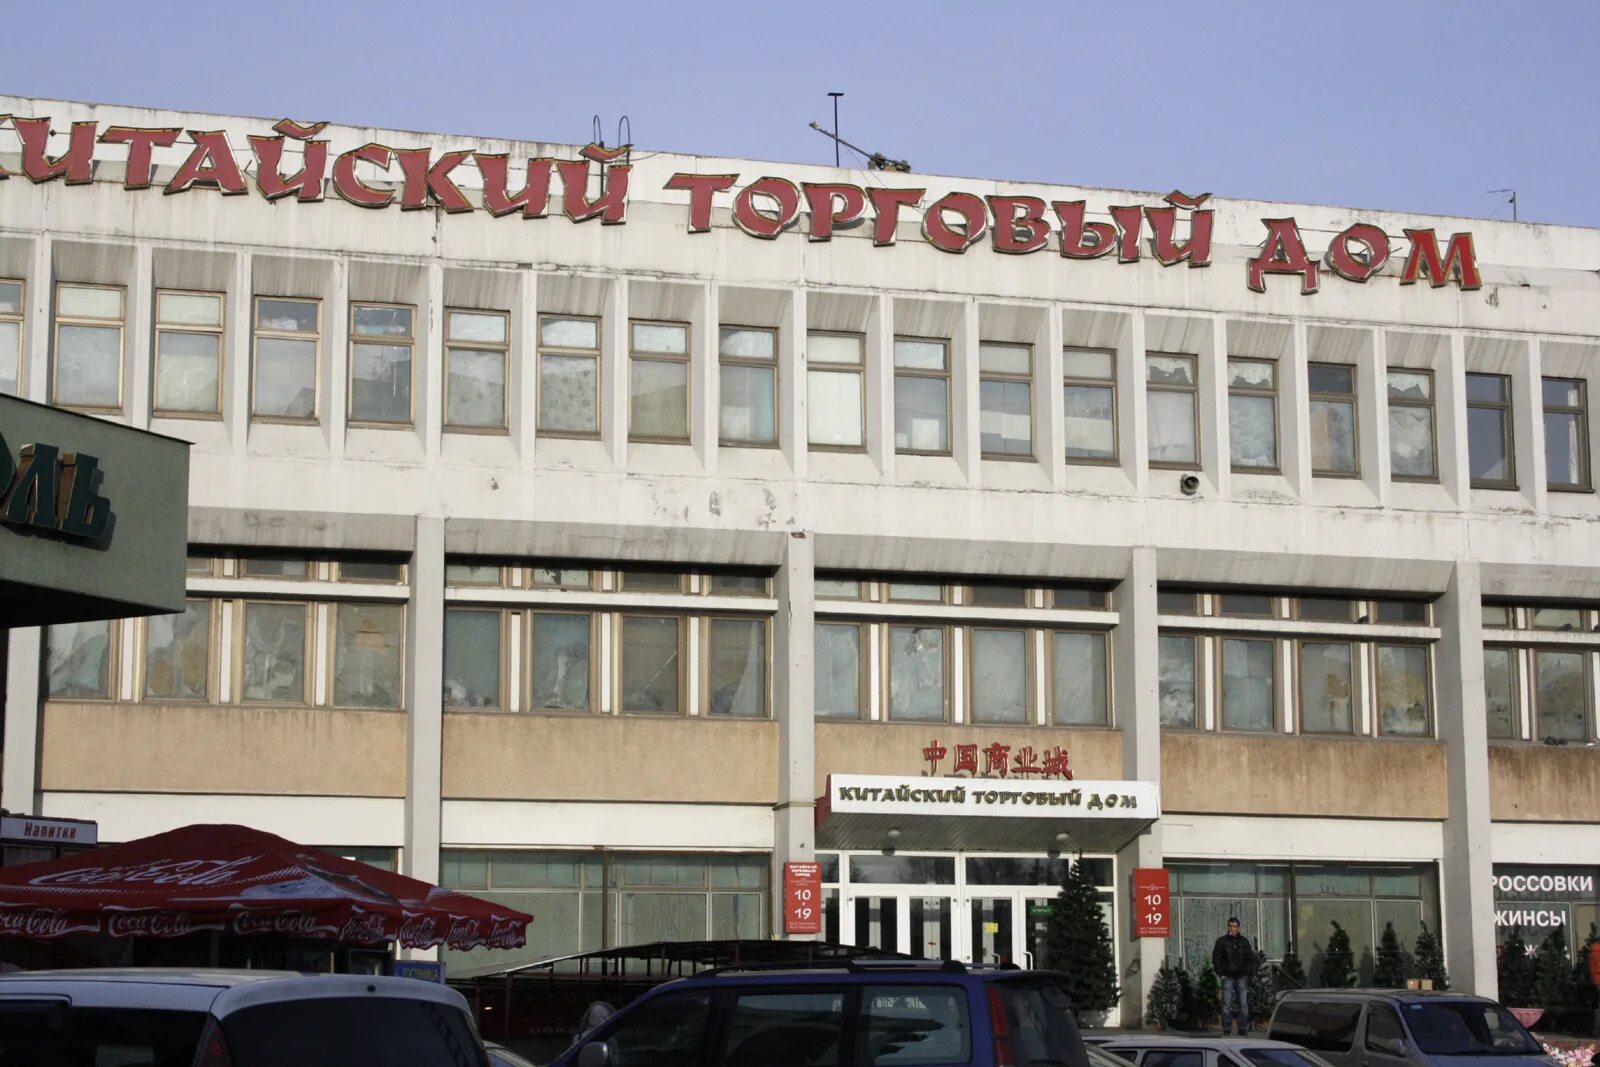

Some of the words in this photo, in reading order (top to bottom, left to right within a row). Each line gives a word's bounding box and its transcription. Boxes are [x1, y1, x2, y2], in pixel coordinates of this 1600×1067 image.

[662, 172, 1215, 268] ТОРГОВЫЙ
[1246, 217, 1483, 295] ДОМ
[922, 739, 1073, 780] 中国商业城
[839, 784, 966, 804] КИТАЙСКИЙ
[971, 788, 1082, 807] ТОРГОВЫЙ
[1087, 793, 1138, 810] ДОМ
[24, 821, 77, 840] Напитки
[794, 889, 811, 901] 10
[1144, 894, 1161, 906] 10
[794, 907, 812, 920] 19
[1145, 912, 1162, 925] 19
